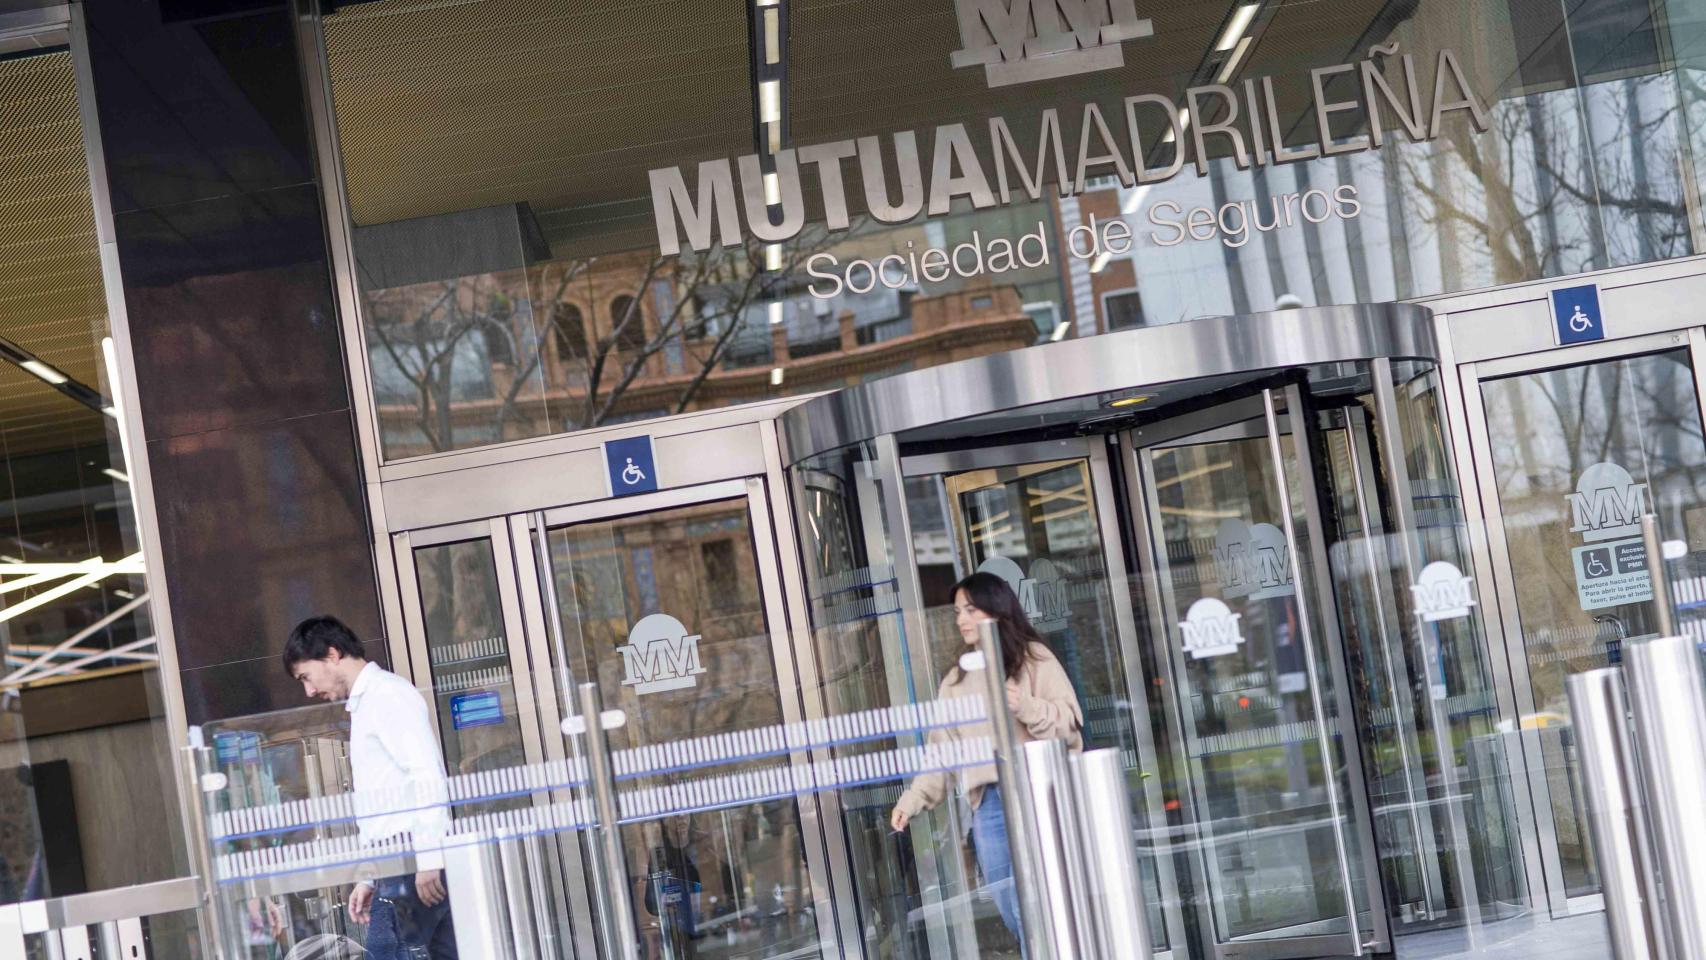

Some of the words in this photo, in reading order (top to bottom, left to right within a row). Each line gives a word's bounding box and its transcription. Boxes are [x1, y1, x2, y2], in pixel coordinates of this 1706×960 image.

[805, 220, 1051, 300] Sociedad
[1068, 213, 1133, 261] de
[1148, 184, 1362, 248] Seguros
[1619, 554, 1648, 562] exclusiv
[616, 635, 707, 686] MM
